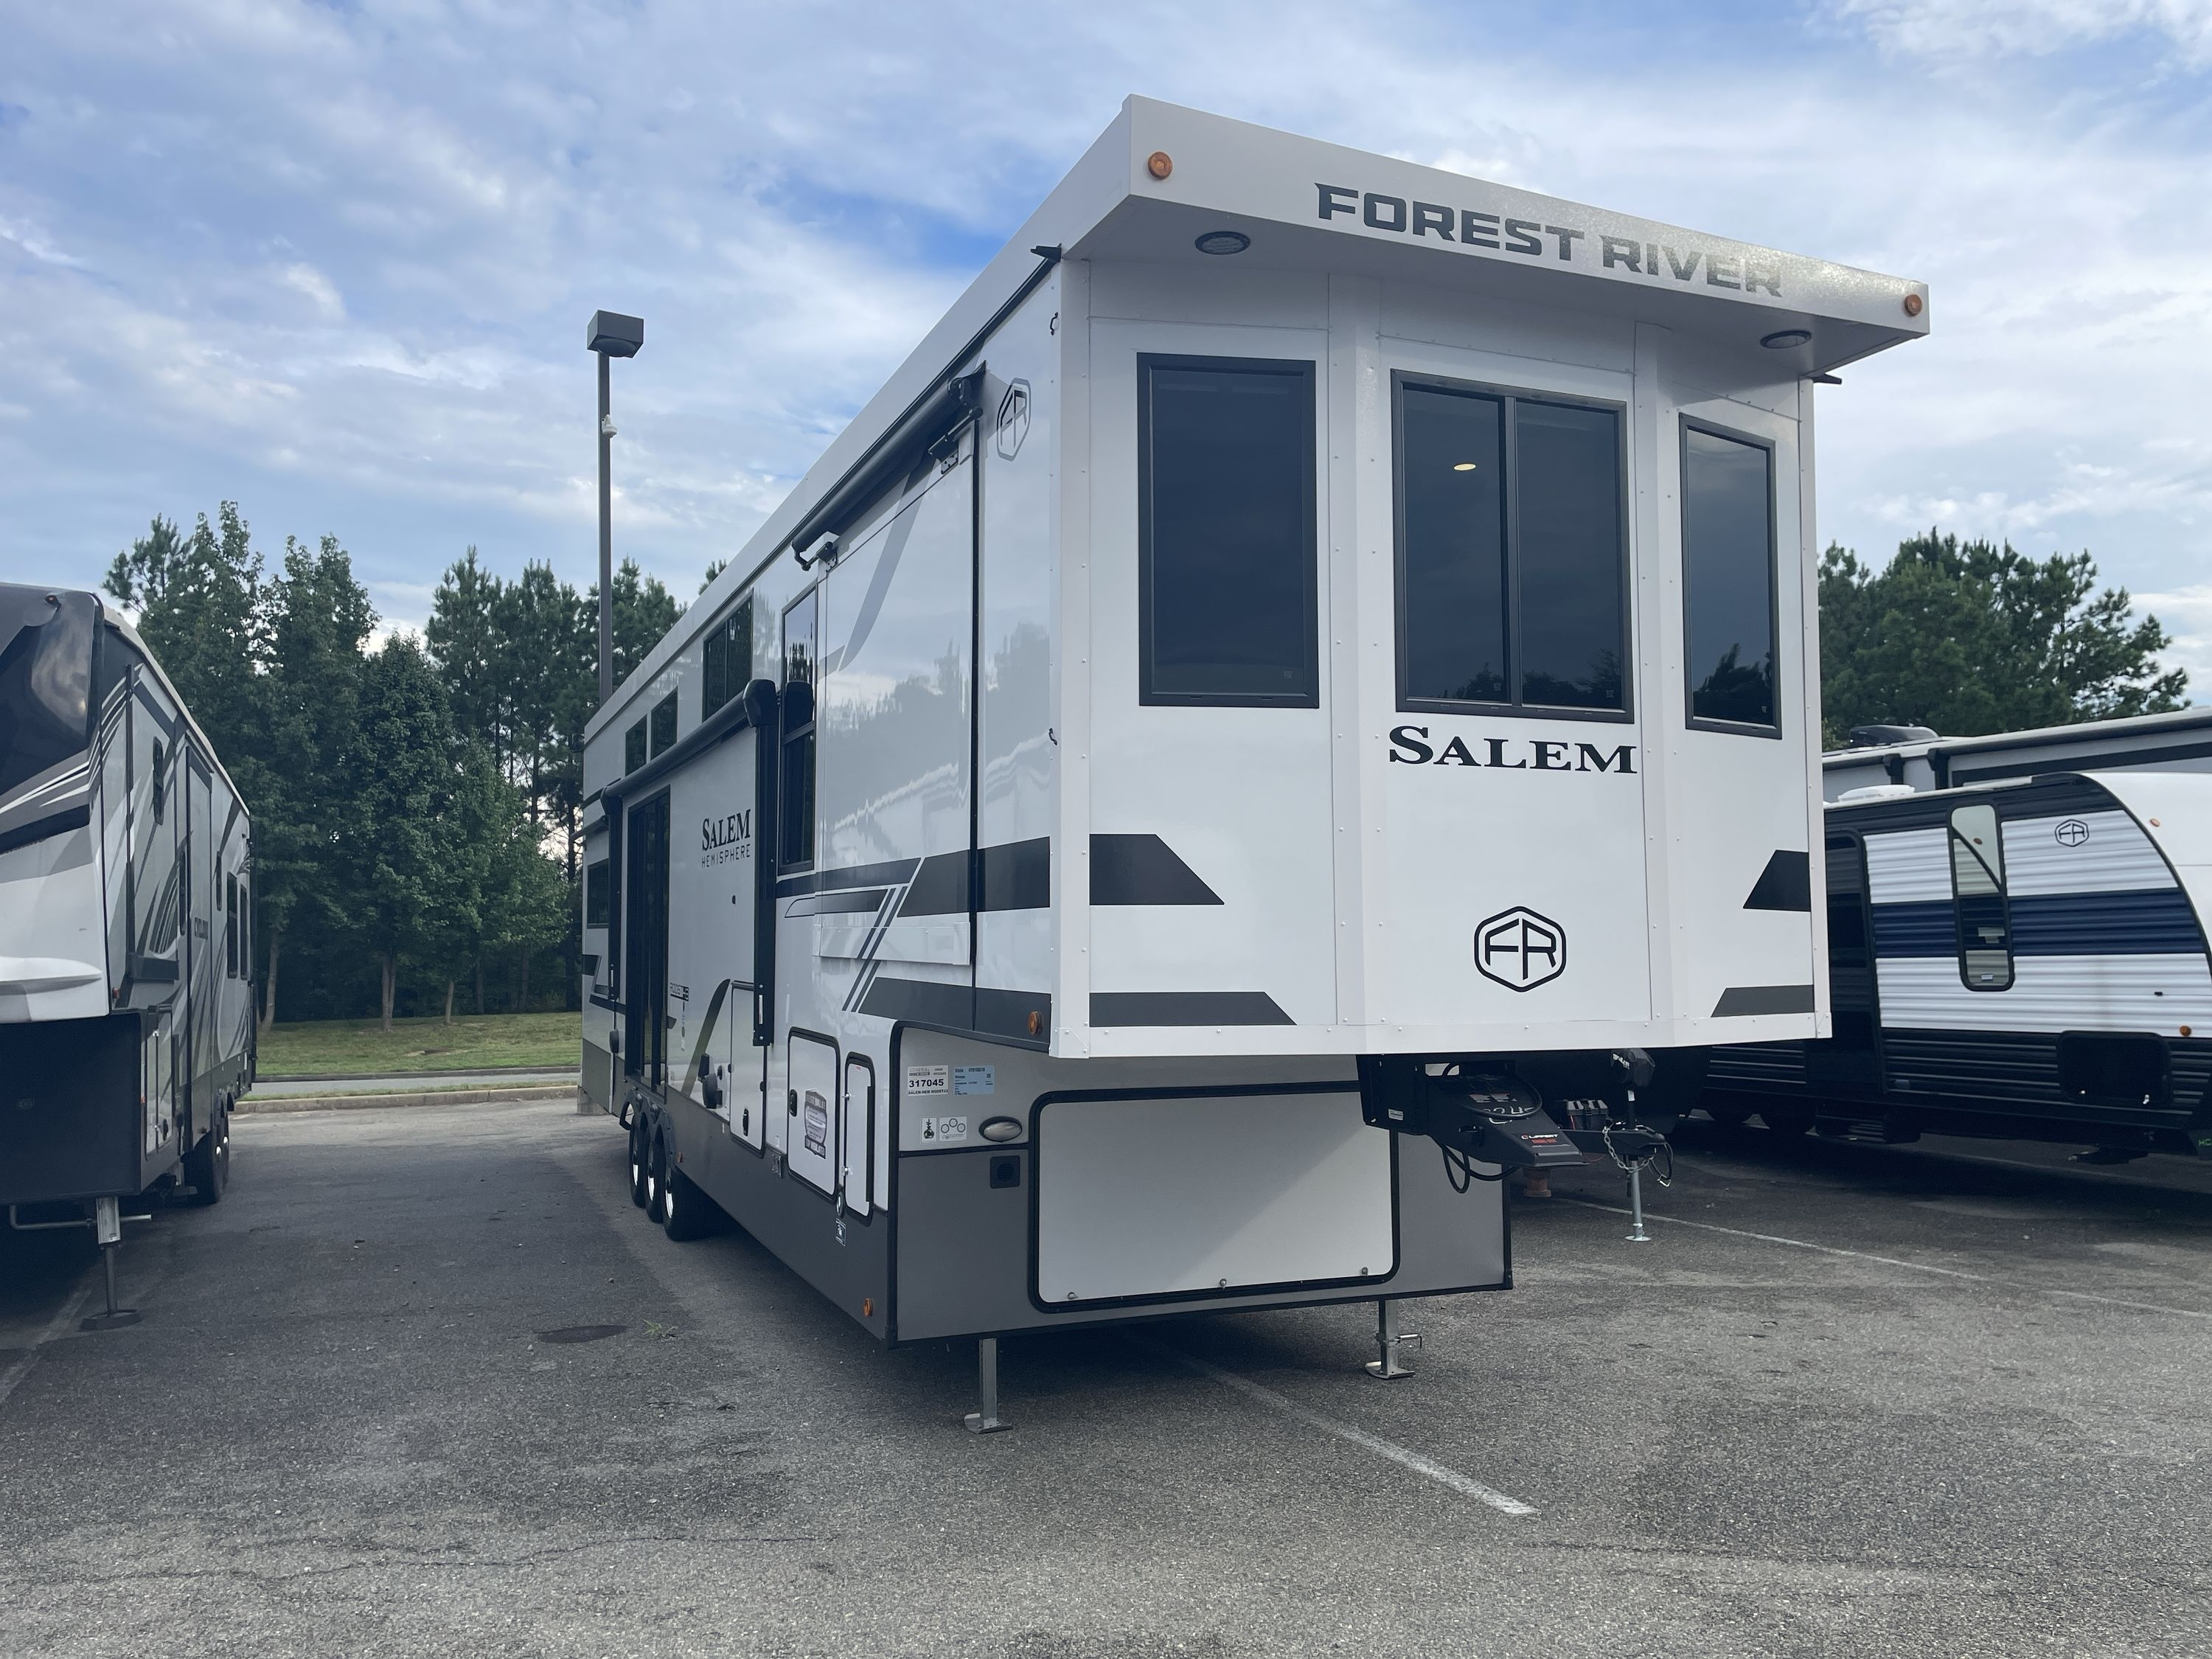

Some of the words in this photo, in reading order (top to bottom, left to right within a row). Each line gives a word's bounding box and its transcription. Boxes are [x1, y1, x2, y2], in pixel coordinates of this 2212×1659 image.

[1314, 182, 1584, 262] FOREST
[1599, 234, 1782, 298] RIVER
[1389, 726, 1638, 774] SALEM
[702, 808, 751, 852] SALEM
[701, 844, 751, 869] HEMISPHERE
[909, 1079, 944, 1088] 317045
